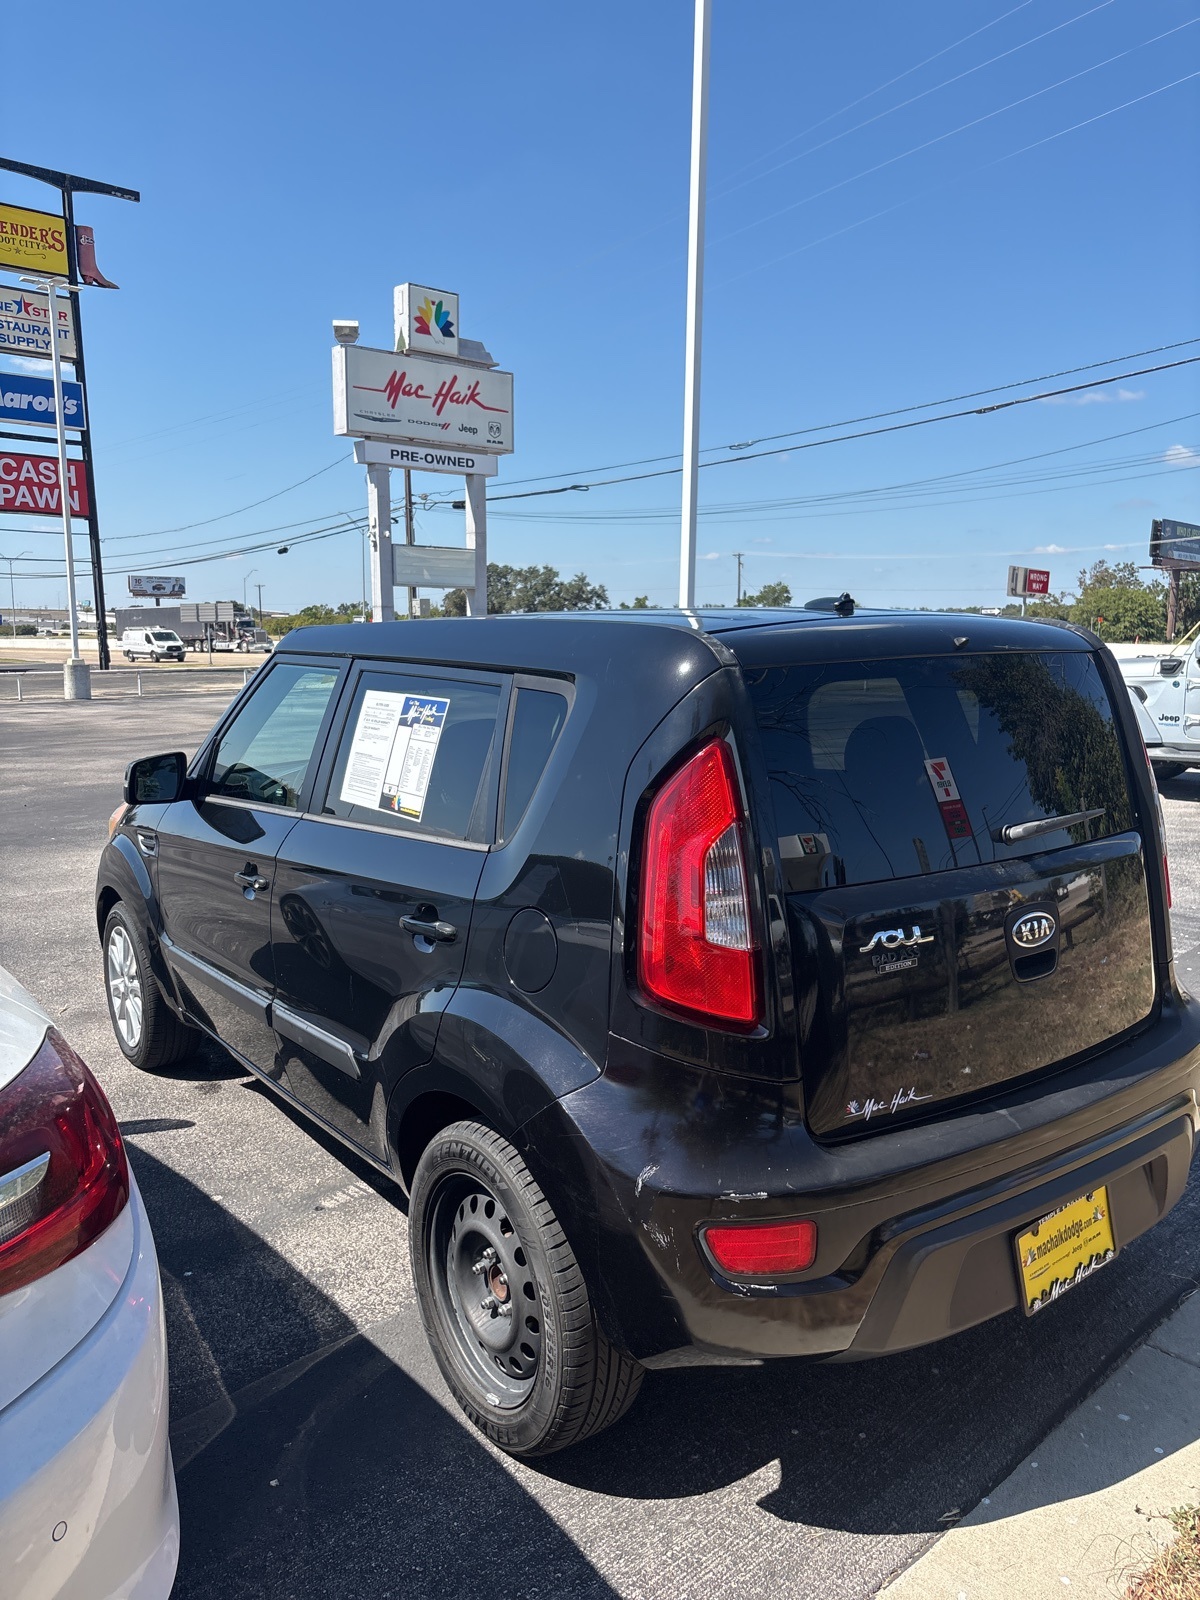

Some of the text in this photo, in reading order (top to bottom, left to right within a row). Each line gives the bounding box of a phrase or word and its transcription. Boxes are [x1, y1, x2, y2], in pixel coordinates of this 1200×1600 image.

[19, 239, 41, 250] CITY
[33, 307, 68, 321] STR
[0, 333, 50, 350] SUPPLY
[353, 370, 509, 416] Mac Haik
[458, 423, 478, 435] Jeep
[390, 448, 475, 469] PRE-OWNED
[0, 458, 76, 486] CASH
[0, 484, 80, 511] PAWN
[1030, 573, 1048, 582] WRONG
[1032, 582, 1044, 590] WAY
[1158, 713, 1180, 723] Jeep
[1020, 919, 1051, 942] KIA
[860, 926, 934, 953] SOUL
[872, 952, 897, 967] BAD
[885, 961, 912, 971] EDITION
[844, 1087, 933, 1121] Mac Haik
[1072, 1243, 1083, 1255] Jeep
